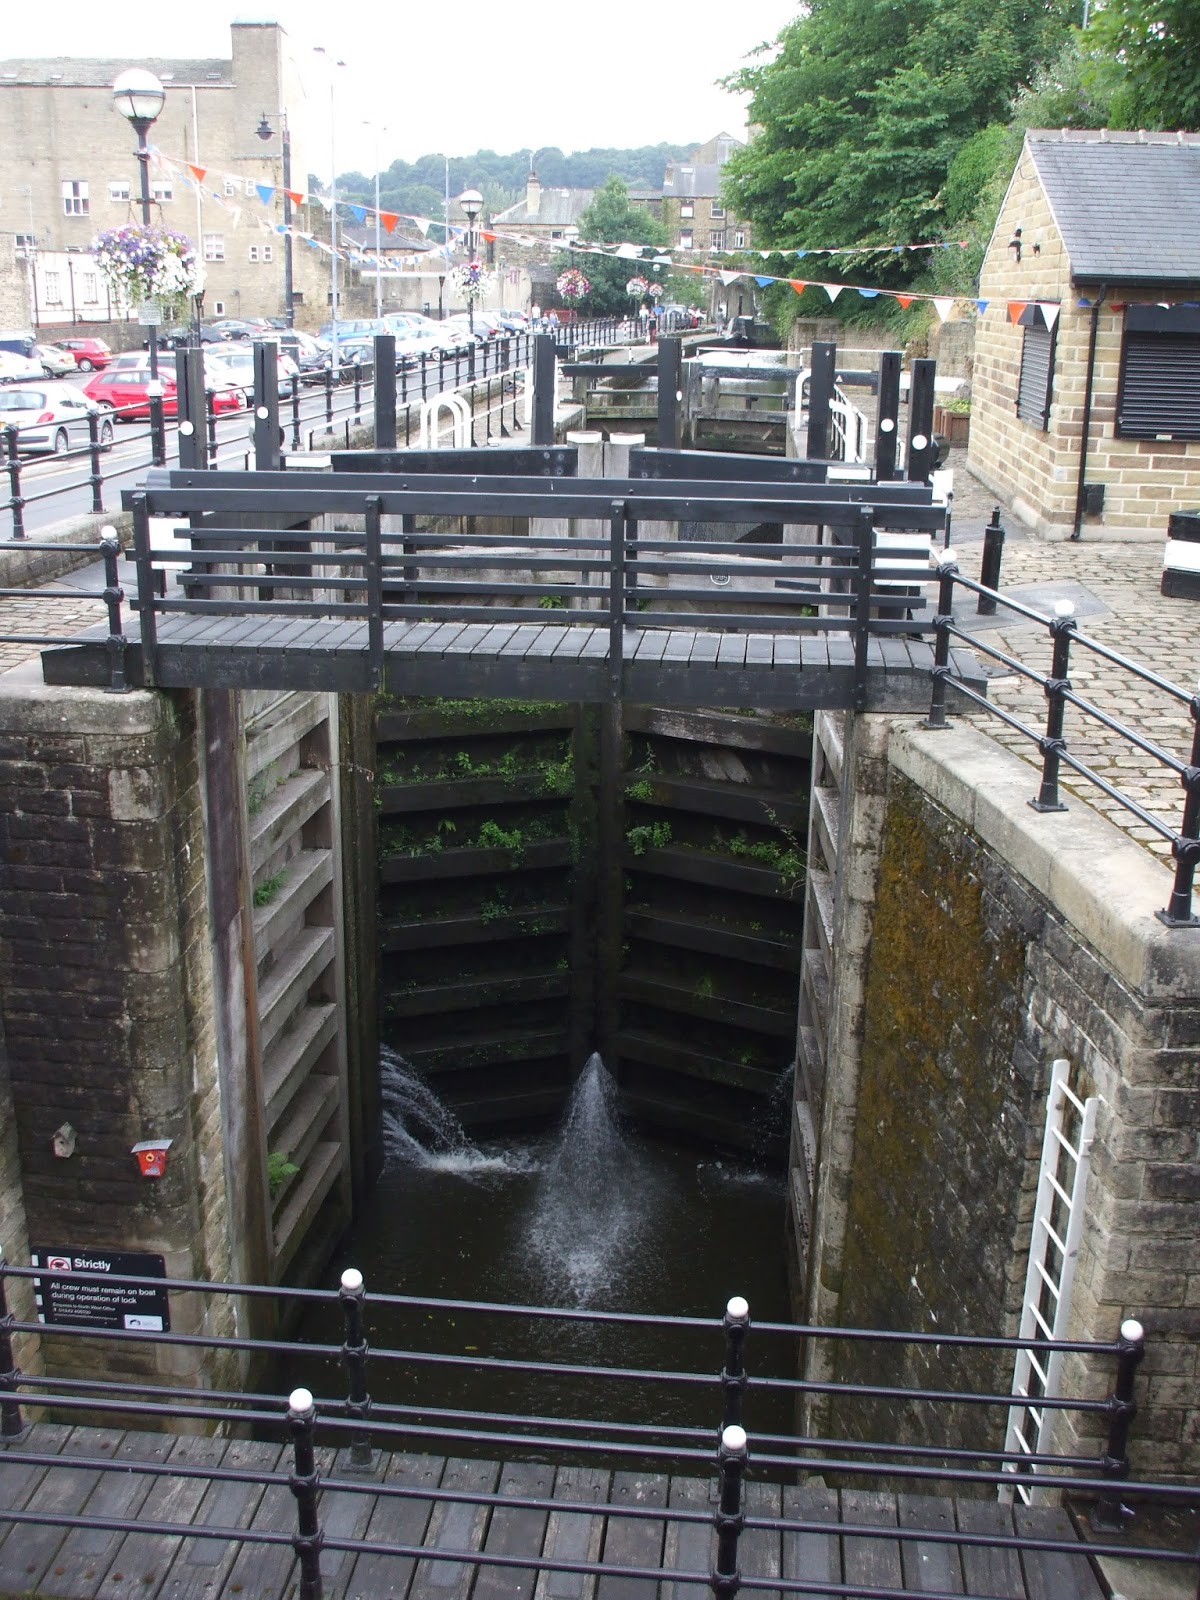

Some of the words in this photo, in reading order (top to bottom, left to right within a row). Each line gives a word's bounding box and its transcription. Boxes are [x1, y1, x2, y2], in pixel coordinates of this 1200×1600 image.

[74, 1258, 111, 1272] Strictly
[50, 1282, 60, 1290] All
[101, 1287, 126, 1295] remain
[138, 1288, 156, 1297] boat
[51, 1292, 75, 1301] during
[76, 1294, 111, 1302] operation
